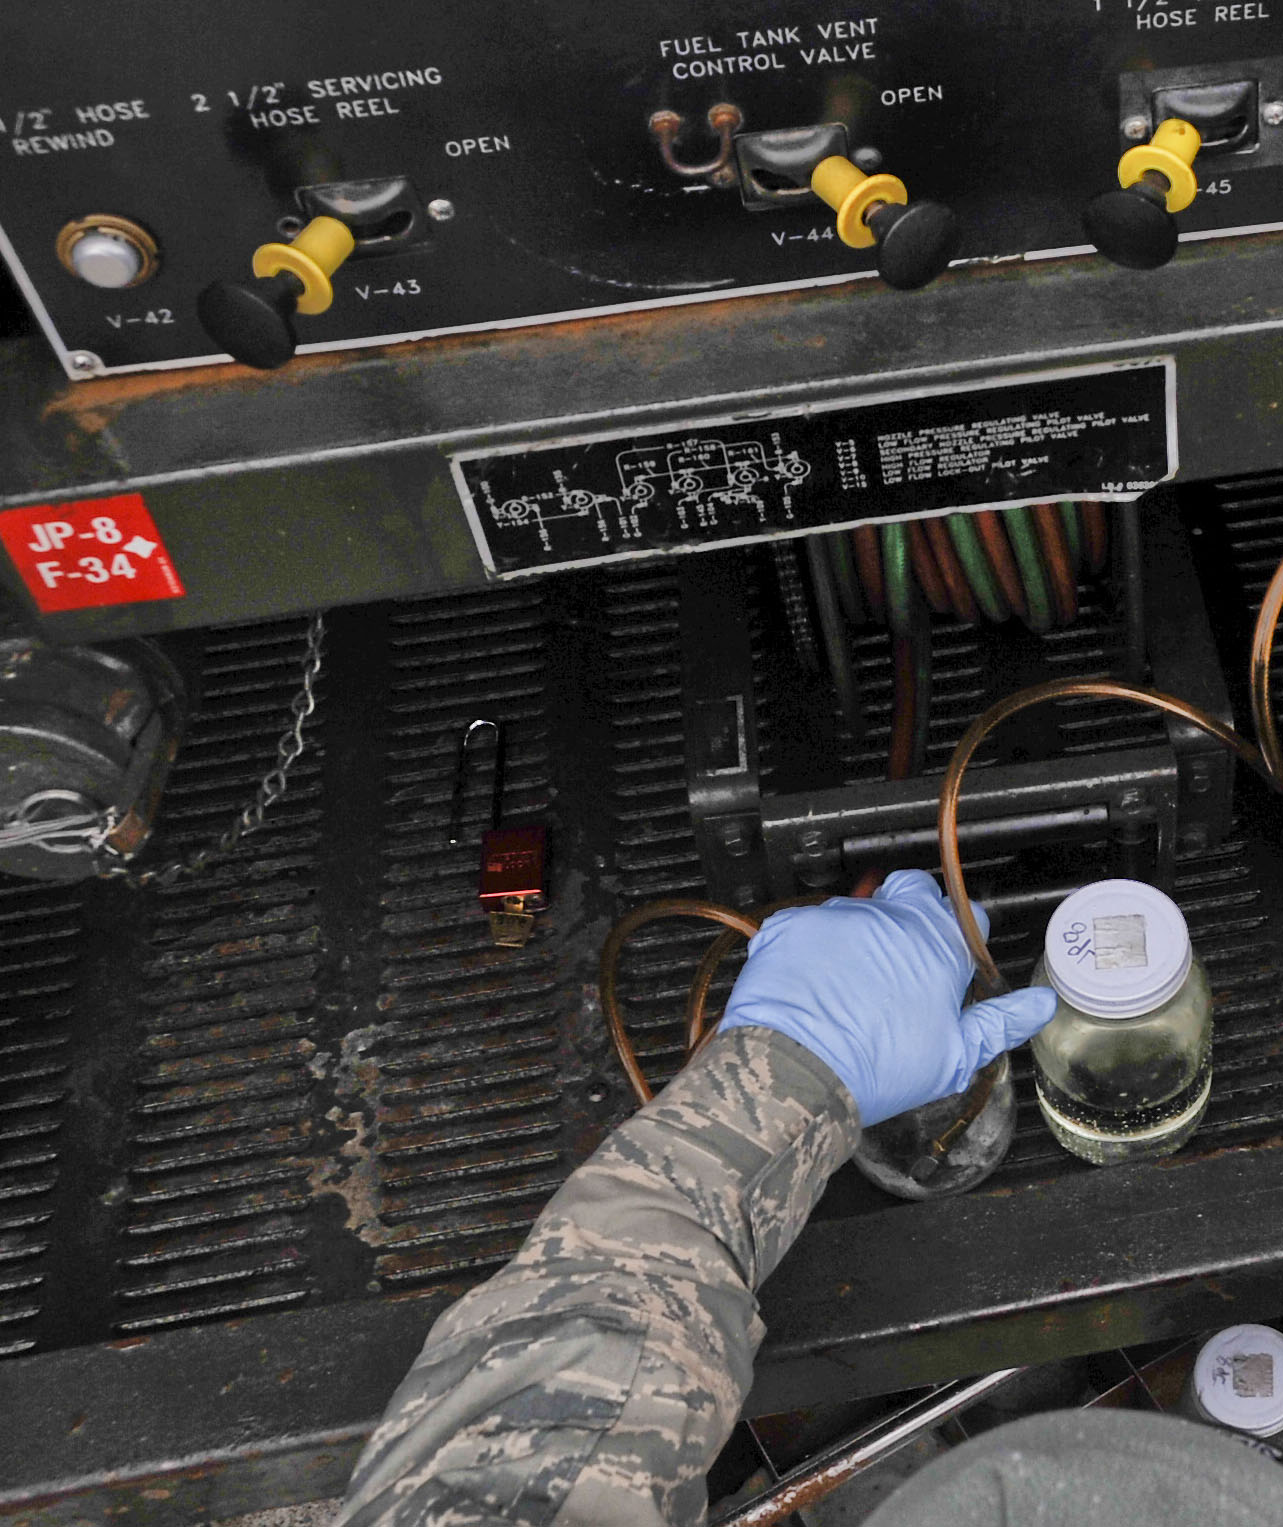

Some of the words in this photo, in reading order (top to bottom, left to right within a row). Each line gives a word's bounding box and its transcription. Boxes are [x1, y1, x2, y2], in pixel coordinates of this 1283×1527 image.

[1136, 8, 1197, 30] HOSE
[1214, 3, 1270, 22] REEL
[658, 36, 722, 58] FUEL
[736, 27, 801, 47] TANK
[817, 18, 879, 38] VENT
[672, 55, 786, 81] CONTROL
[800, 43, 876, 65] VALVE
[190, 93, 211, 112] 2
[307, 67, 443, 99] SERVICING
[881, 85, 944, 106] OPEN
[74, 99, 150, 124] HOSE
[250, 105, 320, 129] HOSE
[335, 96, 400, 121] REEL
[11, 128, 115, 156] REWIND
[445, 135, 512, 158] OPEN
[1196, 179, 1232, 195] -45
[771, 227, 834, 247] V-44
[355, 279, 421, 300] V-43
[106, 308, 175, 329] V-42
[878, 441, 898, 449] LOW
[904, 437, 928, 445] FLOW
[934, 430, 980, 441] PRESSURE
[986, 421, 1041, 435] REGULATING
[1047, 416, 1071, 426] PILOT
[1077, 412, 1104, 421] VALVE
[880, 443, 933, 456] SECONDARY
[980, 430, 1026, 442] PRESSURE
[1032, 423, 1086, 435] REGULATING
[1092, 418, 1116, 427] PILOT
[1122, 414, 1149, 423] VALVE
[919, 424, 965, 435] PRESSURE
[971, 415, 1027, 429] REGULATING
[1033, 411, 1060, 421] VALVE
[908, 448, 954, 459] PRESSURE
[960, 439, 1015, 453] REGULATING
[1020, 435, 1044, 444] PILOT
[1051, 431, 1079, 439] VALVE
[909, 458, 933, 466] FLOW
[939, 450, 991, 462] REGULATOR
[882, 469, 901, 477] LOW
[907, 466, 931, 474] FLOW
[937, 457, 988, 469] REGULATOR
[883, 476, 902, 485] LOW
[908, 473, 932, 481] FLOW
[938, 464, 985, 477] LOCK-OUT
[1021, 456, 1049, 464] VALVE
[27, 516, 123, 552] JP-8
[36, 553, 137, 589] F-34
